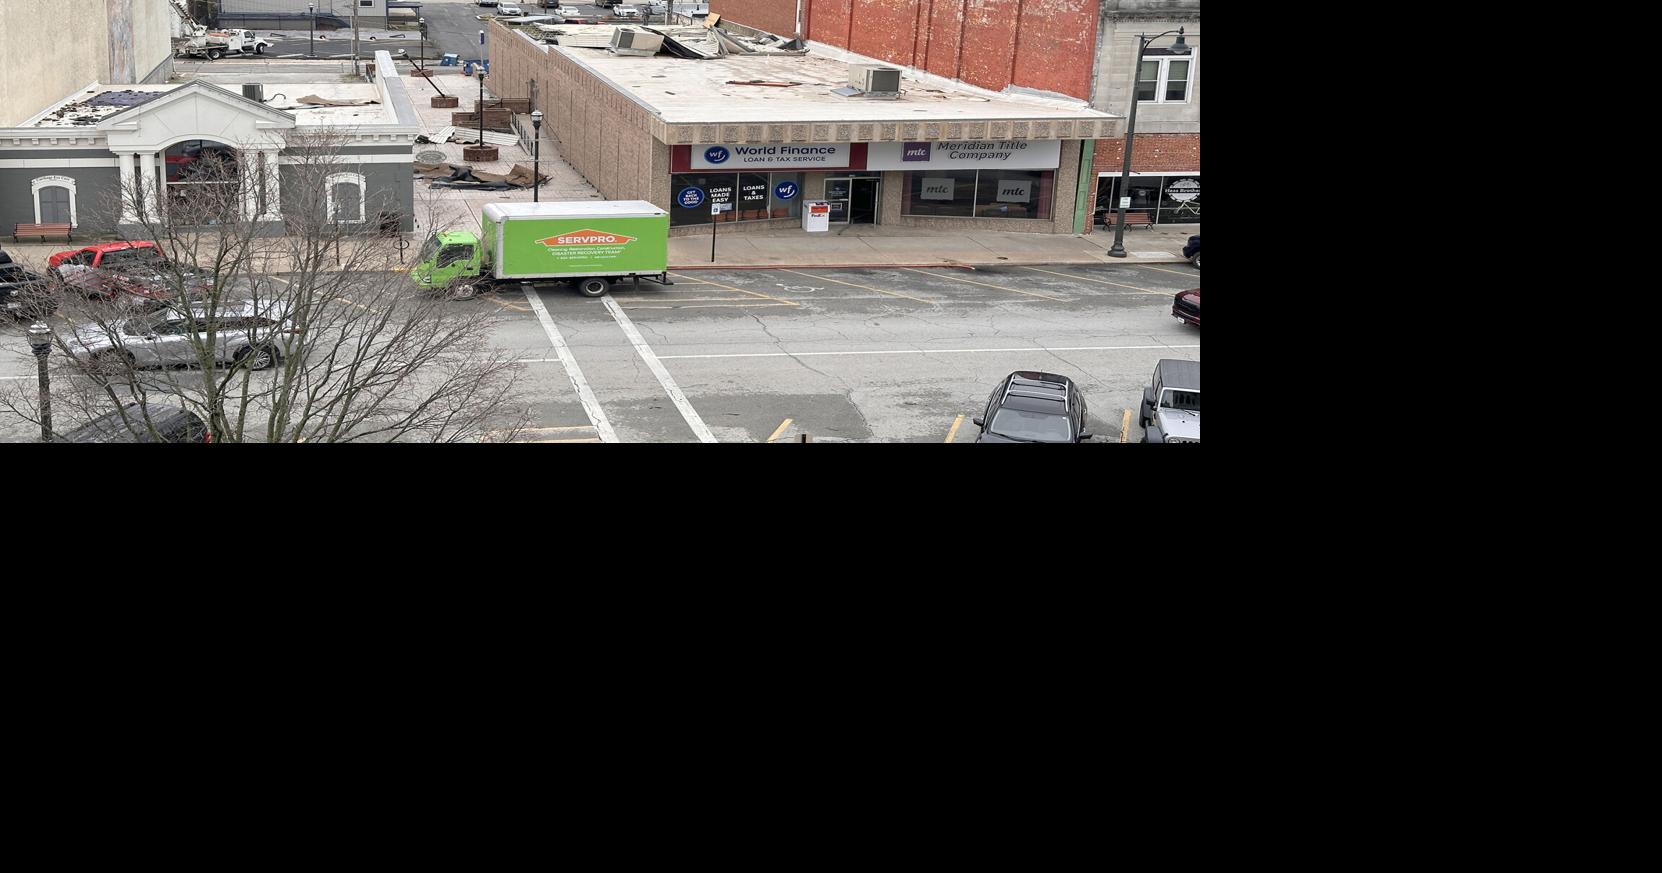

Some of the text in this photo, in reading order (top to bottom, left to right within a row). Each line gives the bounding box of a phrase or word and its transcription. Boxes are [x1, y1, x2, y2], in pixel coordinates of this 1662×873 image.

[937, 141, 1028, 150] Meridian Title
[735, 146, 836, 155] World Finance
[949, 151, 1012, 160] Company
[557, 235, 616, 244] SERVPRO
